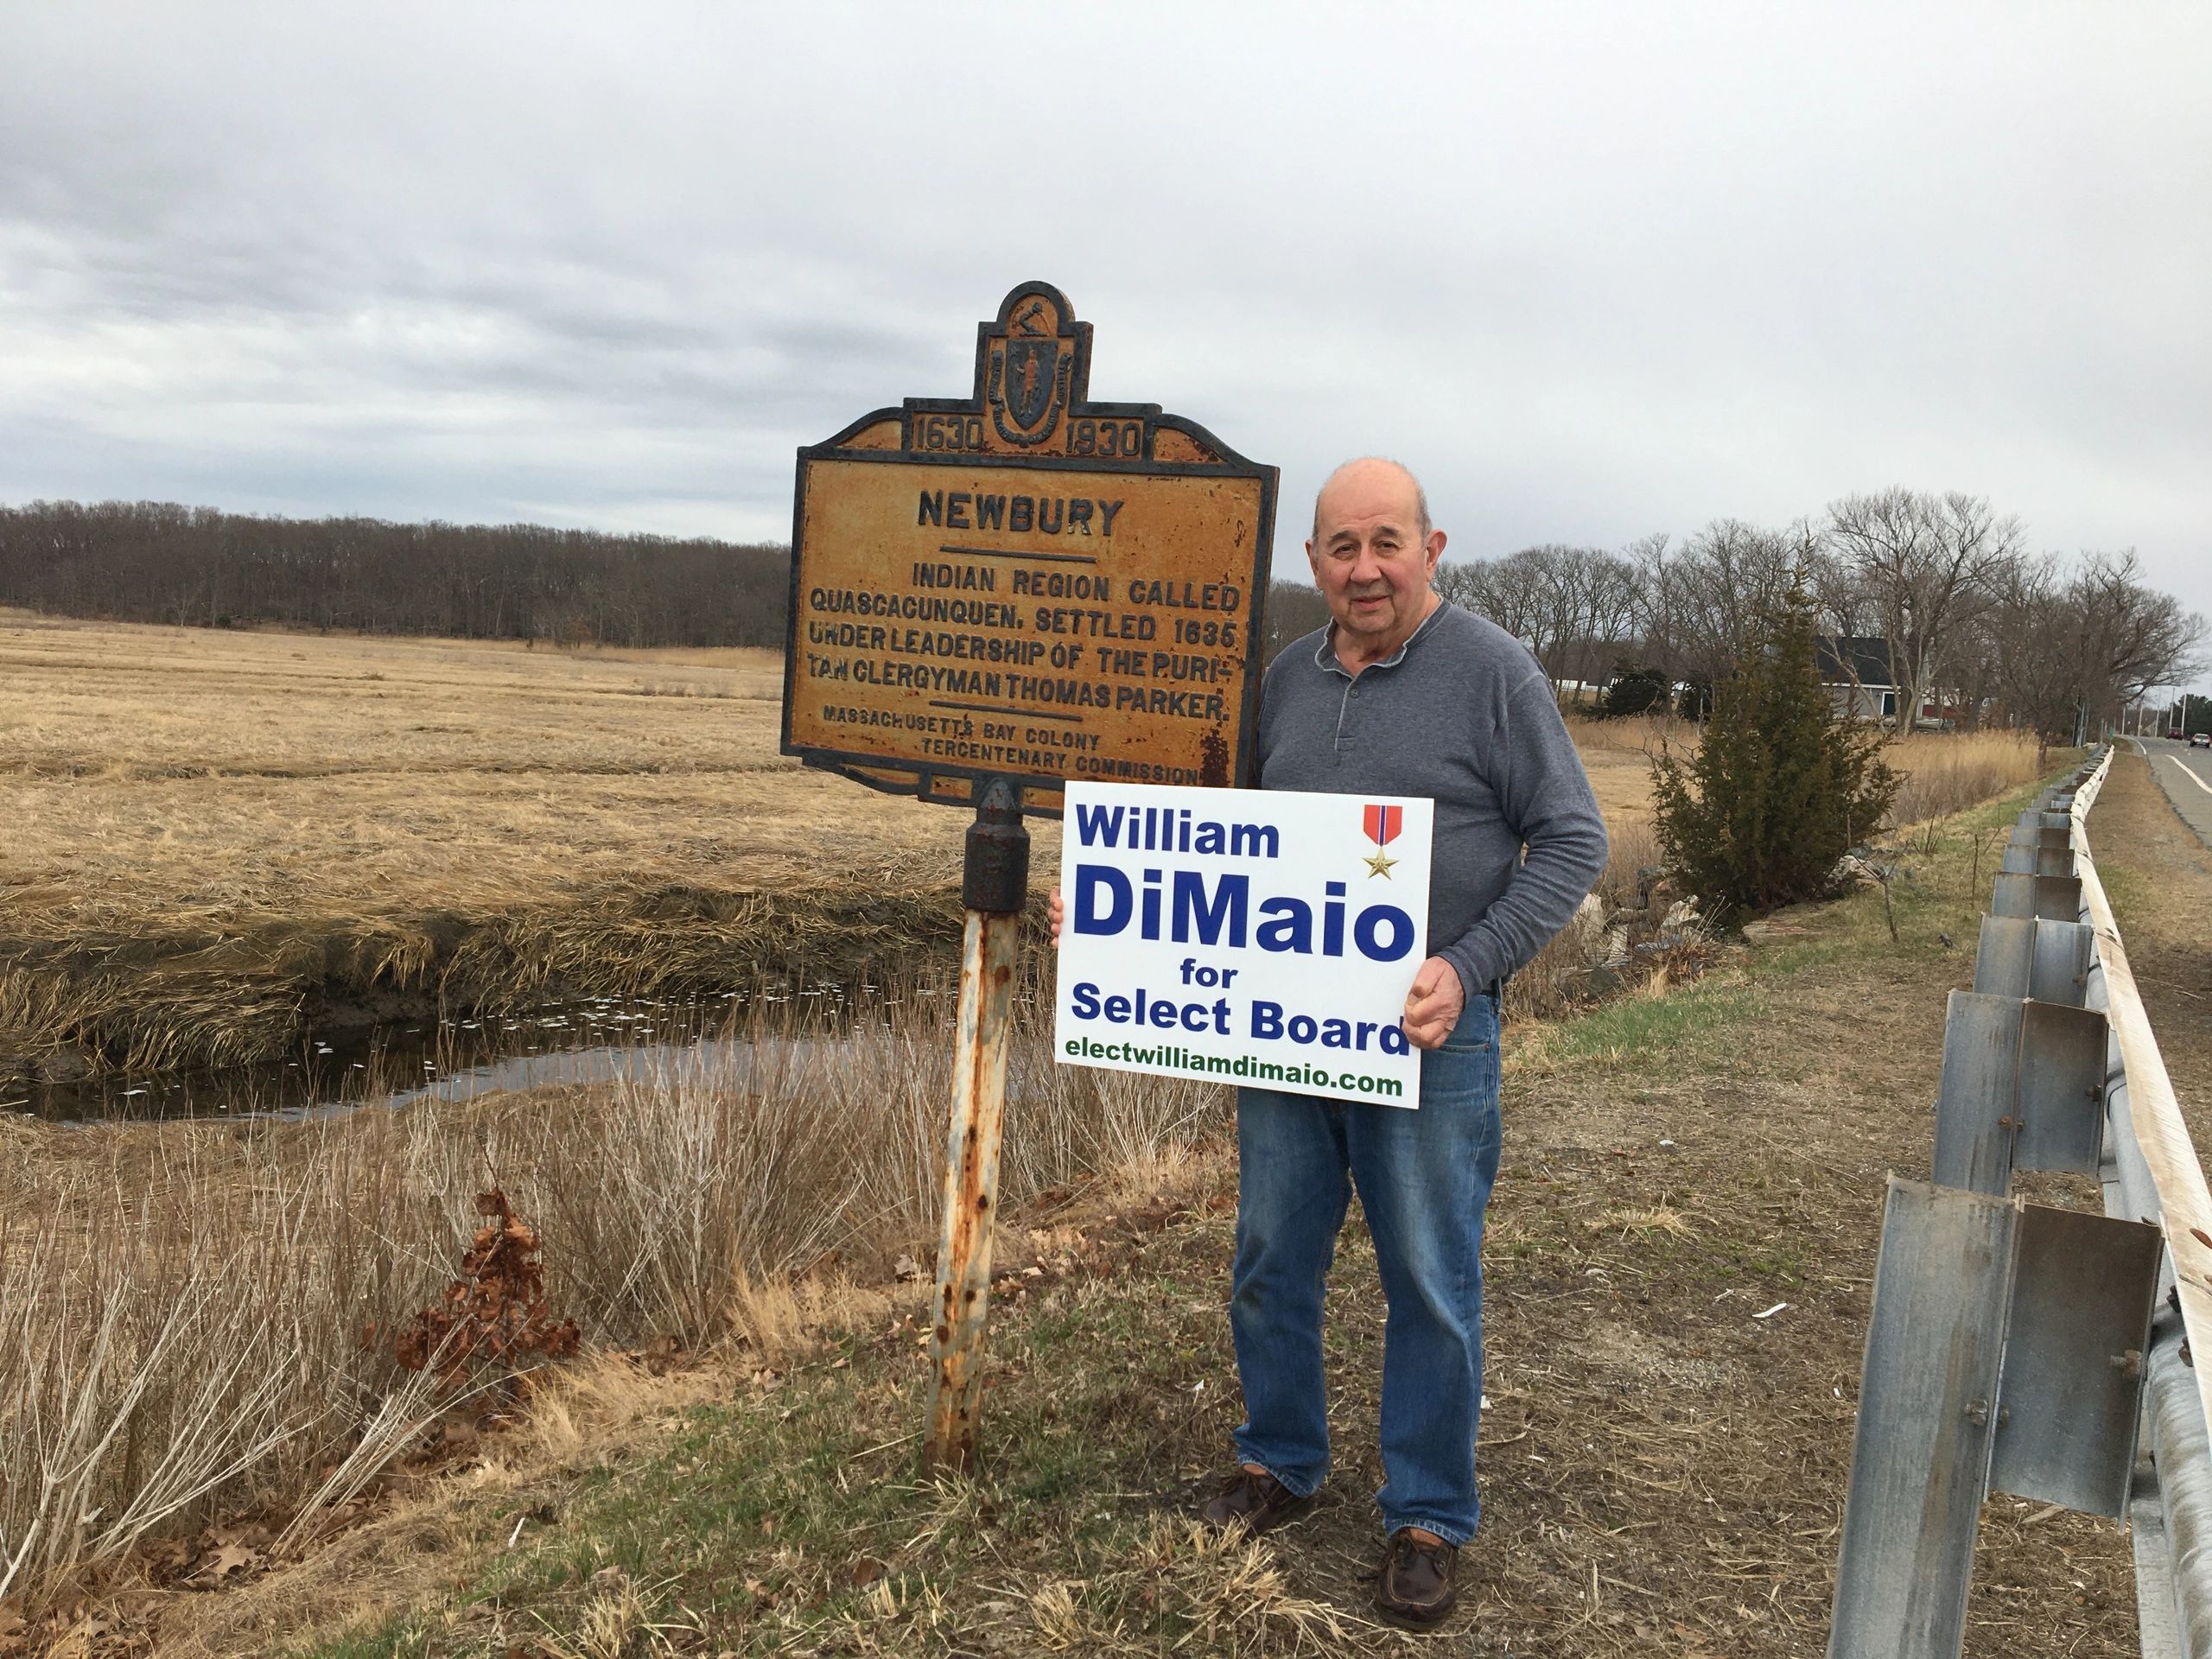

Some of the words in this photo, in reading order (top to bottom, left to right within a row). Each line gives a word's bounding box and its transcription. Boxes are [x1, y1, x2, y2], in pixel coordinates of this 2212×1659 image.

[917, 416, 983, 449] 1630
[1065, 420, 1141, 457] 1930
[918, 489, 1124, 537] NEWBURY
[912, 563, 995, 592] INDIAN
[1012, 569, 1109, 601] REGION
[1128, 579, 1241, 612] CALLED
[809, 620, 887, 650] UNDER
[890, 627, 1046, 666] LEADERSHIP
[1050, 643, 1084, 670] OF
[1096, 646, 1148, 677] THE
[1152, 652, 1233, 683] PURI-
[1035, 607, 1156, 640] SETTLED
[1174, 618, 1237, 648] 1635
[807, 651, 849, 681] TAN
[852, 658, 1001, 697] CLERGYMAN
[1005, 673, 1111, 708] THOMAS
[1116, 685, 1230, 721] PARKER.
[823, 704, 975, 736] MASSACHUSETTS
[983, 721, 1017, 741] BAY
[1025, 728, 1102, 751] COLONY
[921, 737, 1067, 769] TERCENTENARY
[1075, 755, 1198, 785] COMMISSION
[1075, 804, 1280, 858] William
[1073, 863, 1415, 963] DiMaio
[1179, 957, 1238, 988] for
[1071, 982, 1231, 1035] Select
[1250, 1000, 1410, 1056] Board
[1065, 1037, 1402, 1096] electwilliamdimaio.com
